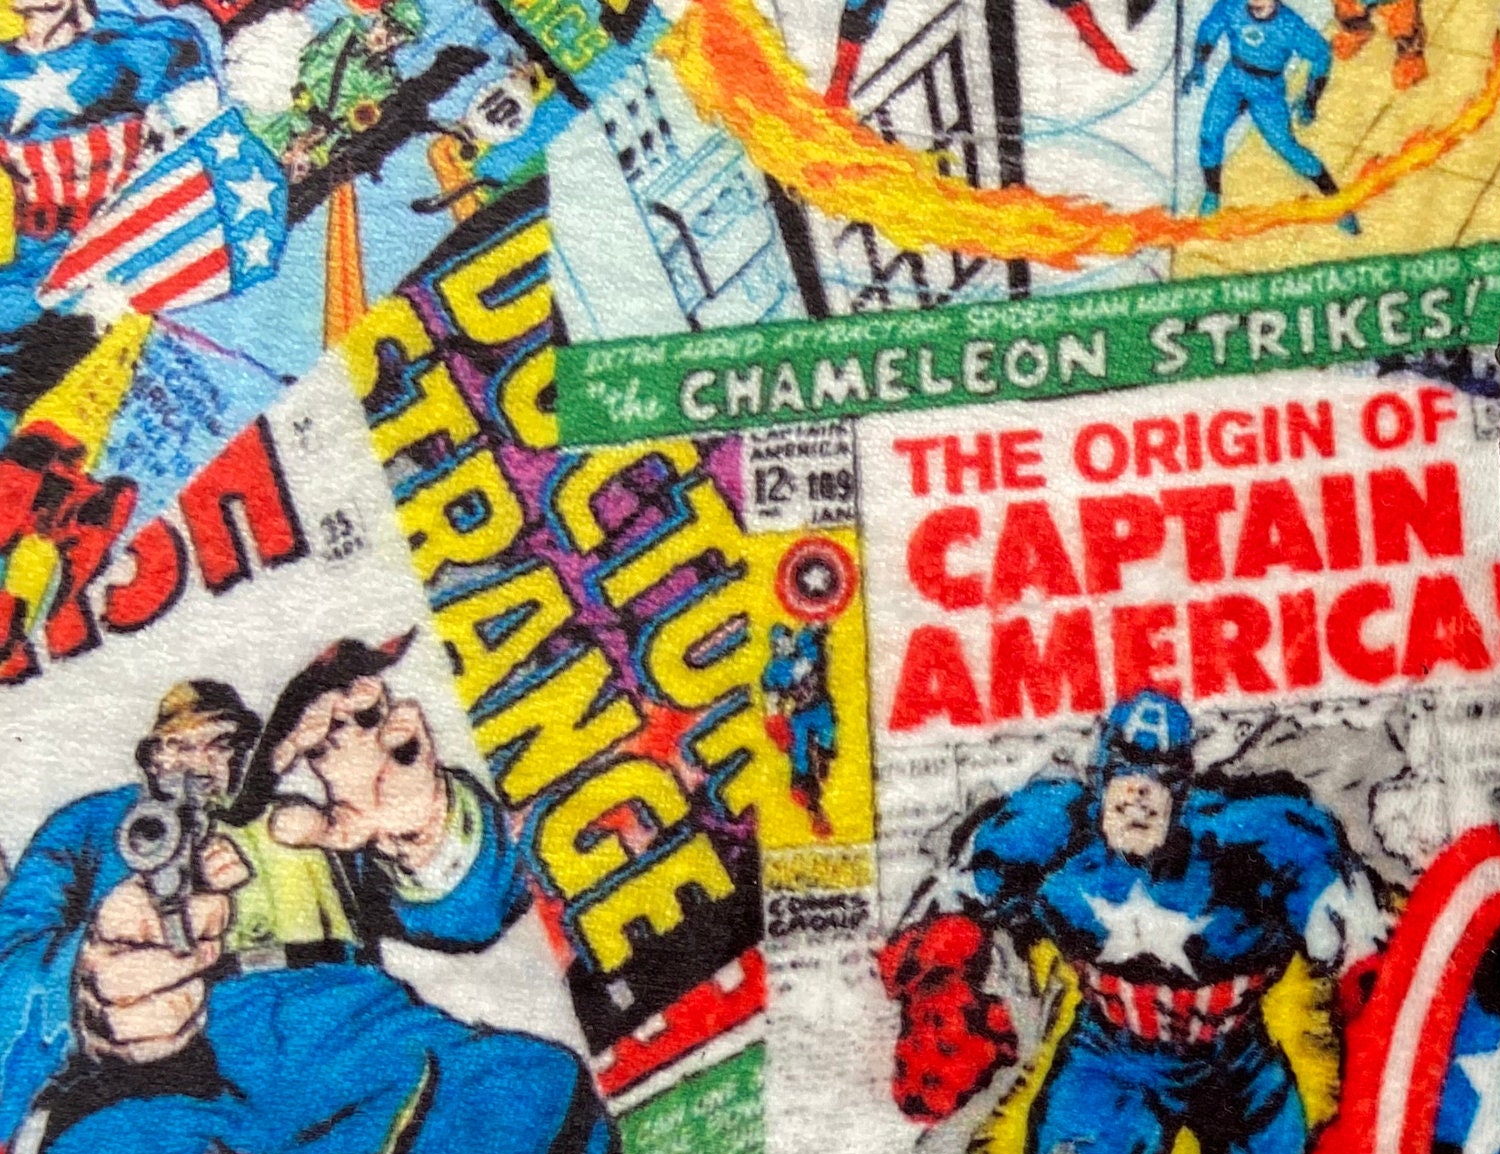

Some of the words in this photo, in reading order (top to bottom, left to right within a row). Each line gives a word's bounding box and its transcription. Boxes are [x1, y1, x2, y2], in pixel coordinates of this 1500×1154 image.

[1220, 278, 1262, 304] THE
[1270, 262, 1392, 299] FANTASTIC
[680, 328, 1107, 421] CHAMELEON
[892, 428, 1046, 496] THE
[1073, 399, 1336, 484] ORIGIN
[1360, 385, 1458, 451] OF
[905, 460, 1465, 612] CAPTAIN
